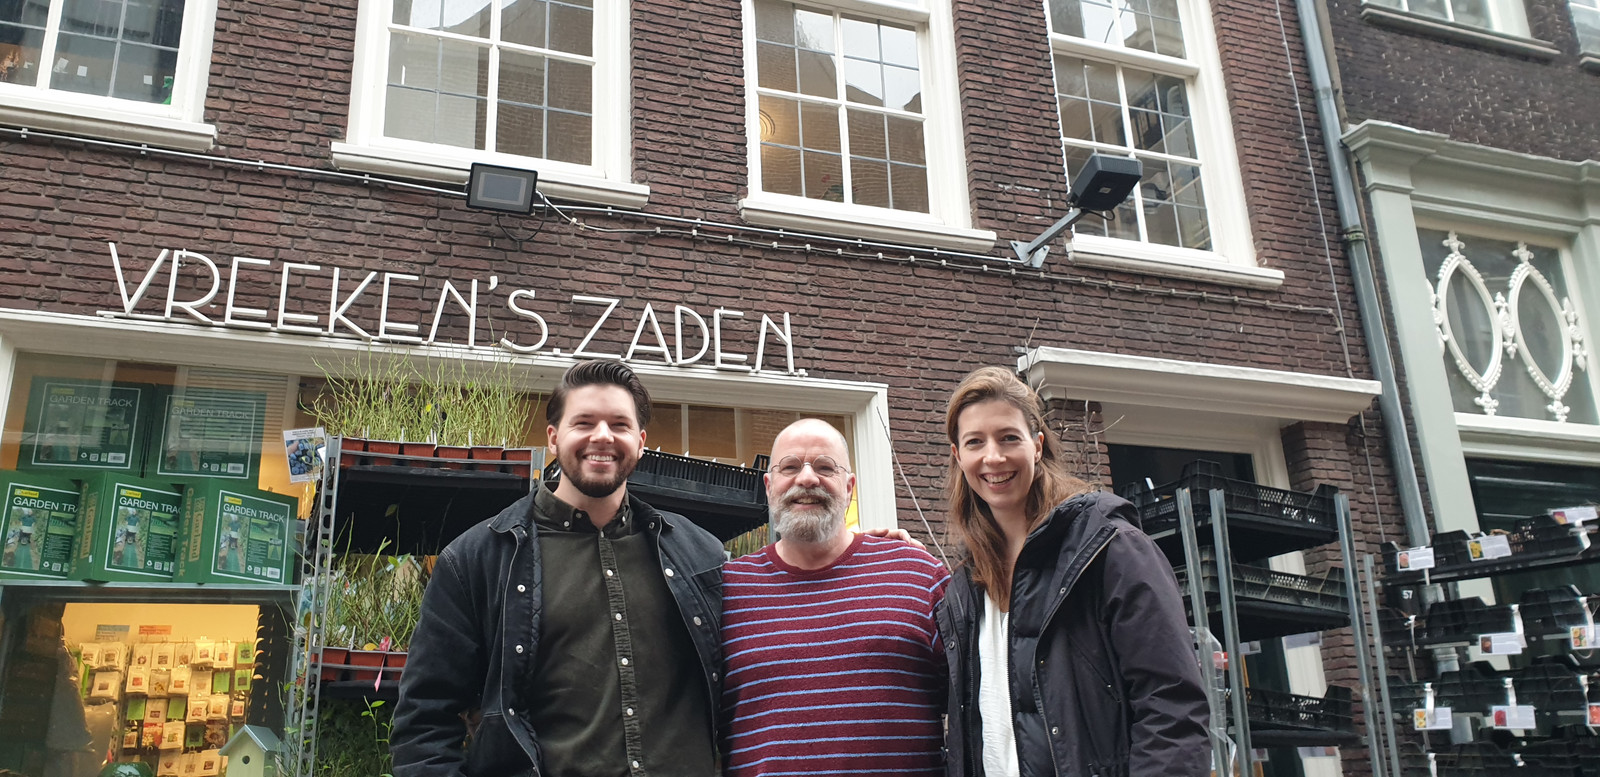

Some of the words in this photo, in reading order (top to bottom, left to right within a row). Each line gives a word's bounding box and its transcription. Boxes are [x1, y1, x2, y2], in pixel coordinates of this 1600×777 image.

[49, 395, 95, 405] GARDEN
[97, 397, 133, 407] TRACK
[172, 406, 213, 416] GARDEN
[216, 410, 251, 419] TRACK
[13, 496, 59, 511] GARDEN
[119, 496, 159, 511] GARDEN
[223, 503, 257, 517] GARDEN
[259, 510, 285, 522] TRACK
[1402, 590, 1413, 600] 57
